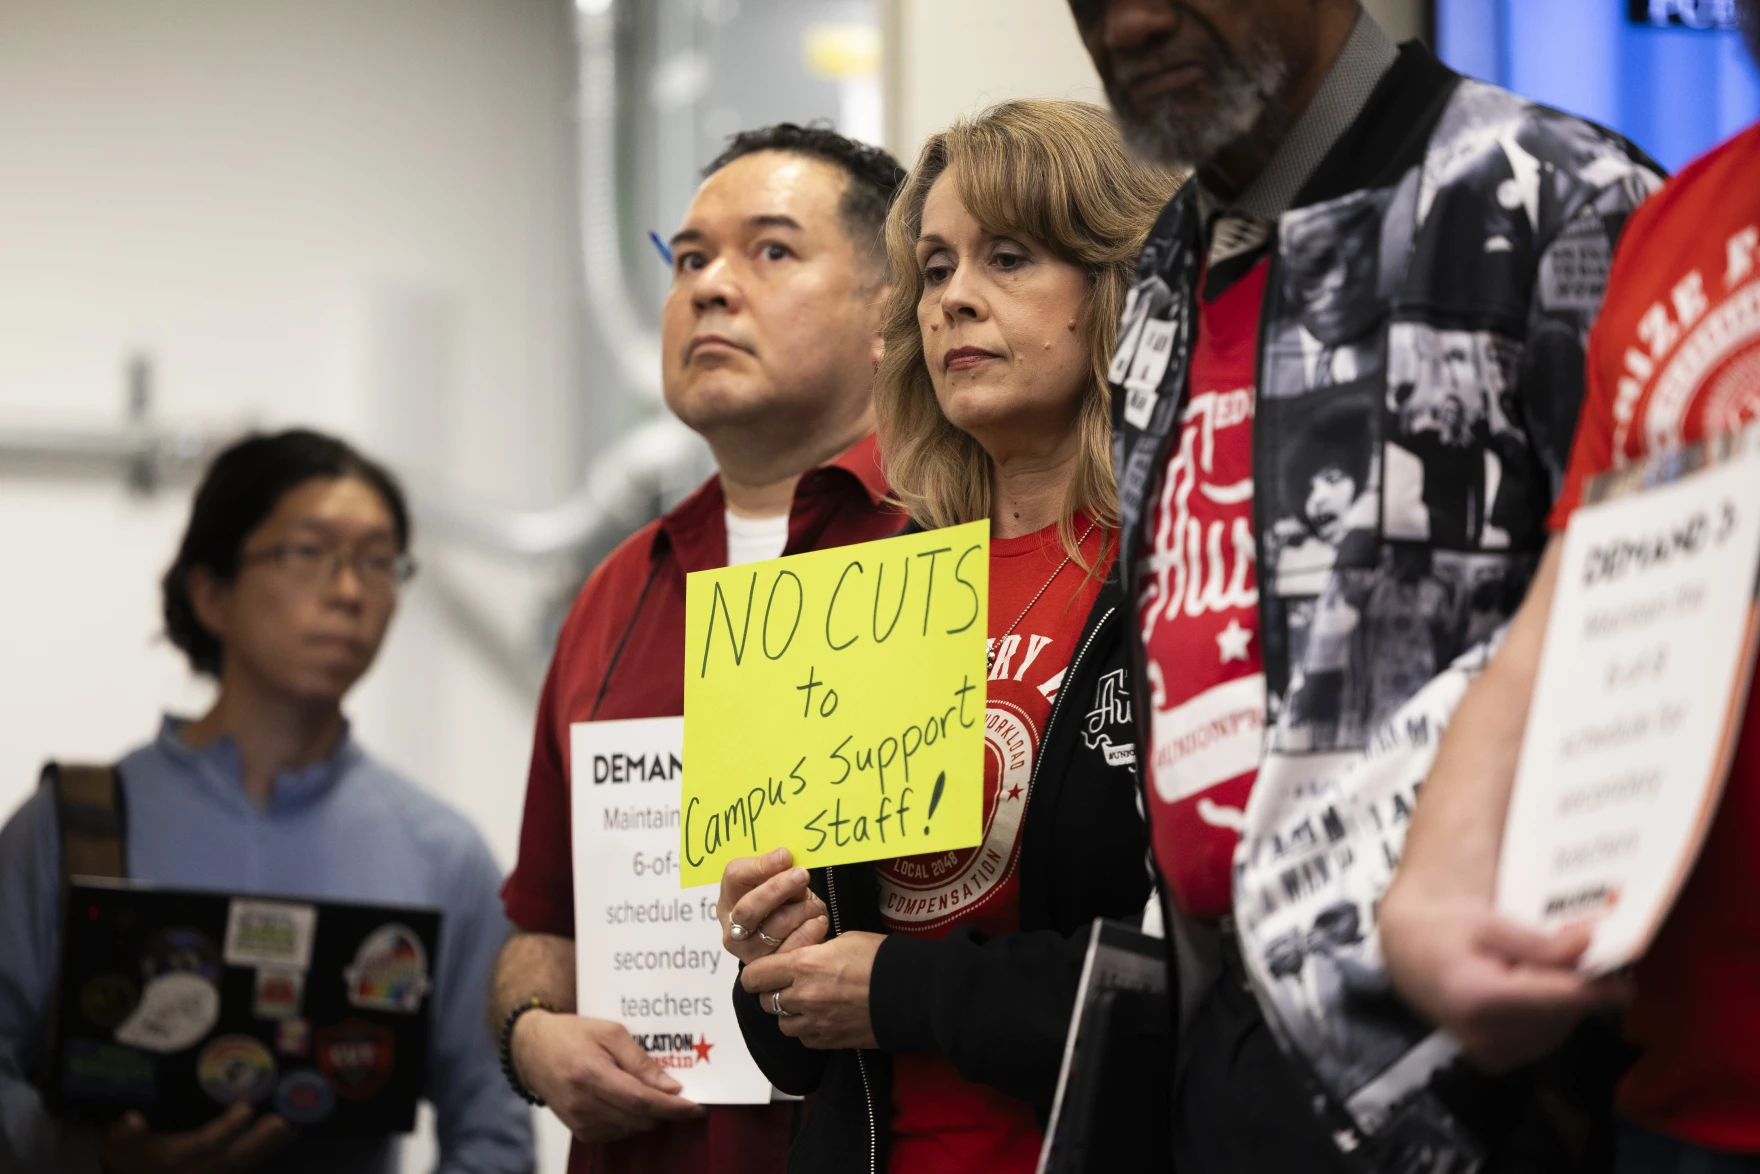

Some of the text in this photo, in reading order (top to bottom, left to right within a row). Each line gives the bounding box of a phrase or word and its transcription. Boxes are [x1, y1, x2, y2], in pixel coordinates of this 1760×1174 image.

[701, 544, 982, 679] NO CUTS
[796, 666, 838, 718] to
[604, 805, 681, 830] Maintain
[632, 850, 681, 877] 6-of-
[893, 850, 958, 879] LOCAL 2048
[887, 848, 1002, 915] COMPENSATION
[605, 898, 694, 925] schedule
[613, 944, 721, 975] secondary
[620, 992, 714, 1017] teachers
